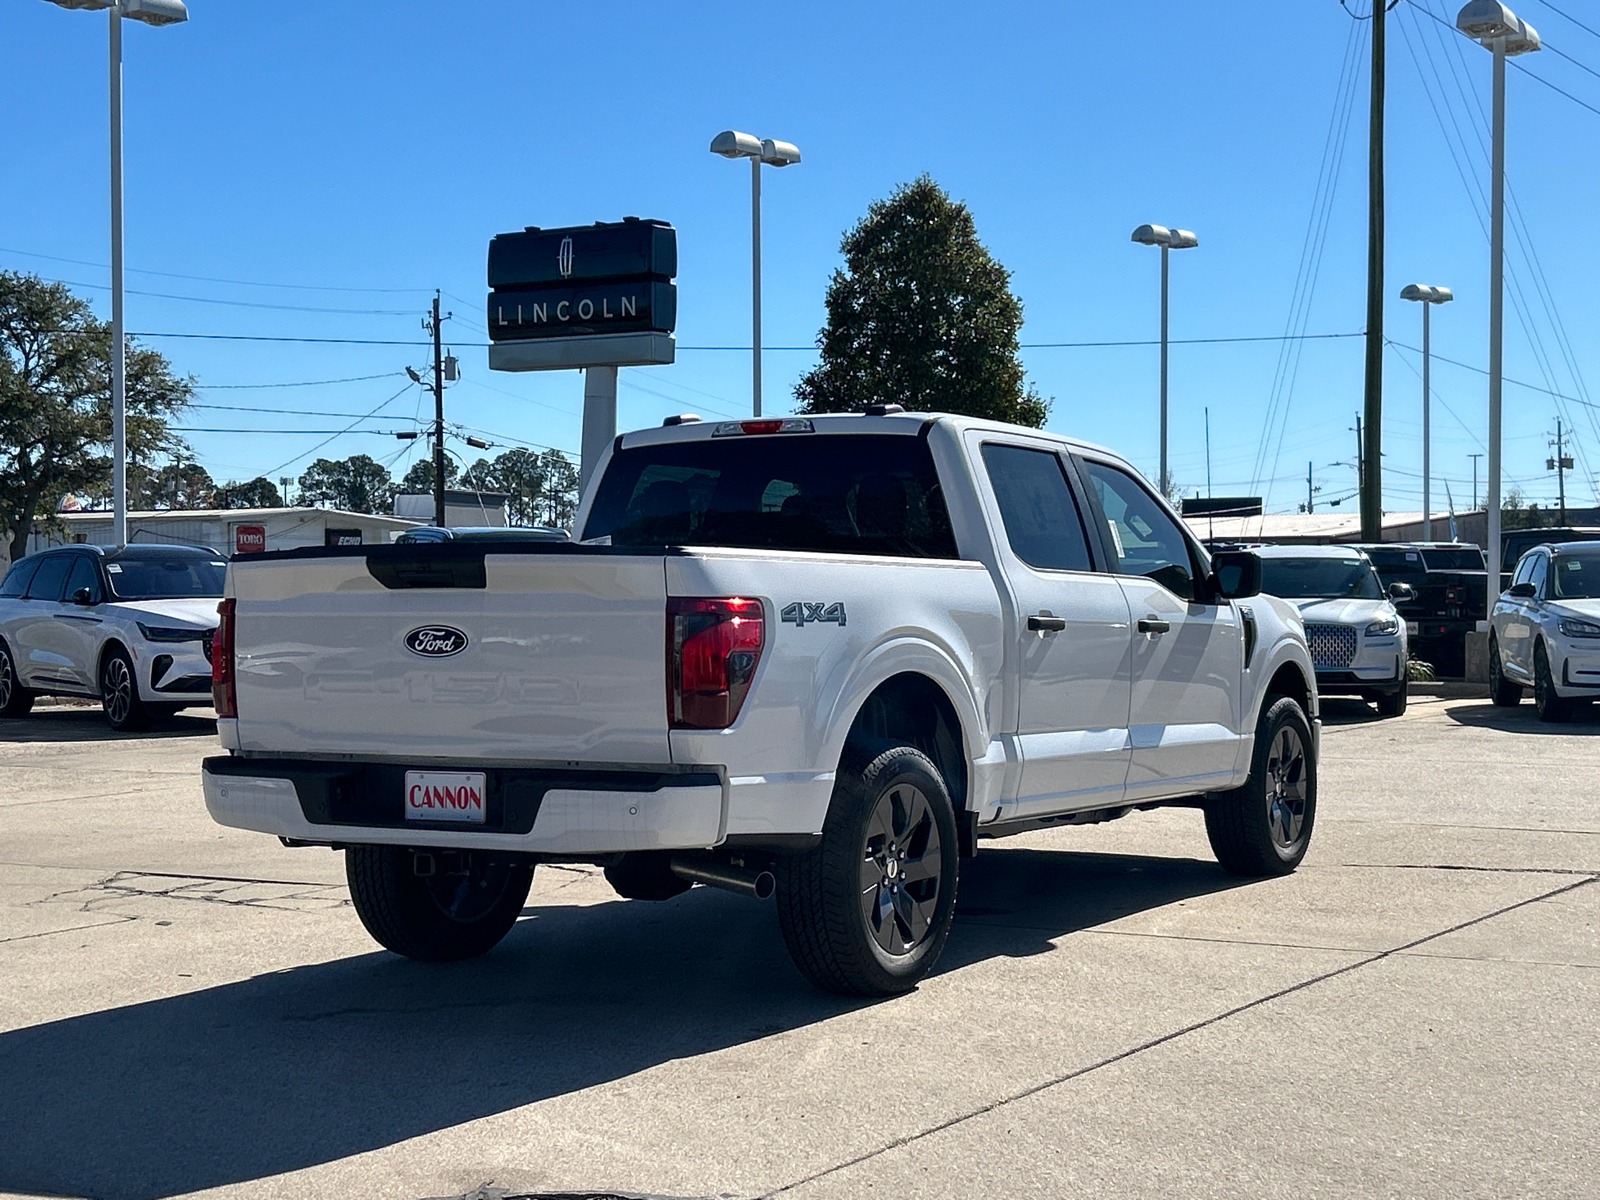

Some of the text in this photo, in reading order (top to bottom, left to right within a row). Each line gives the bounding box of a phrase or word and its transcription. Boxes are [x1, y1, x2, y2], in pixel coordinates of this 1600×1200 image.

[498, 296, 636, 326] LINCOLN
[238, 534, 263, 545] TORO
[337, 536, 361, 546] ECHO
[415, 629, 456, 652] Ford
[409, 784, 482, 810] CANNON
